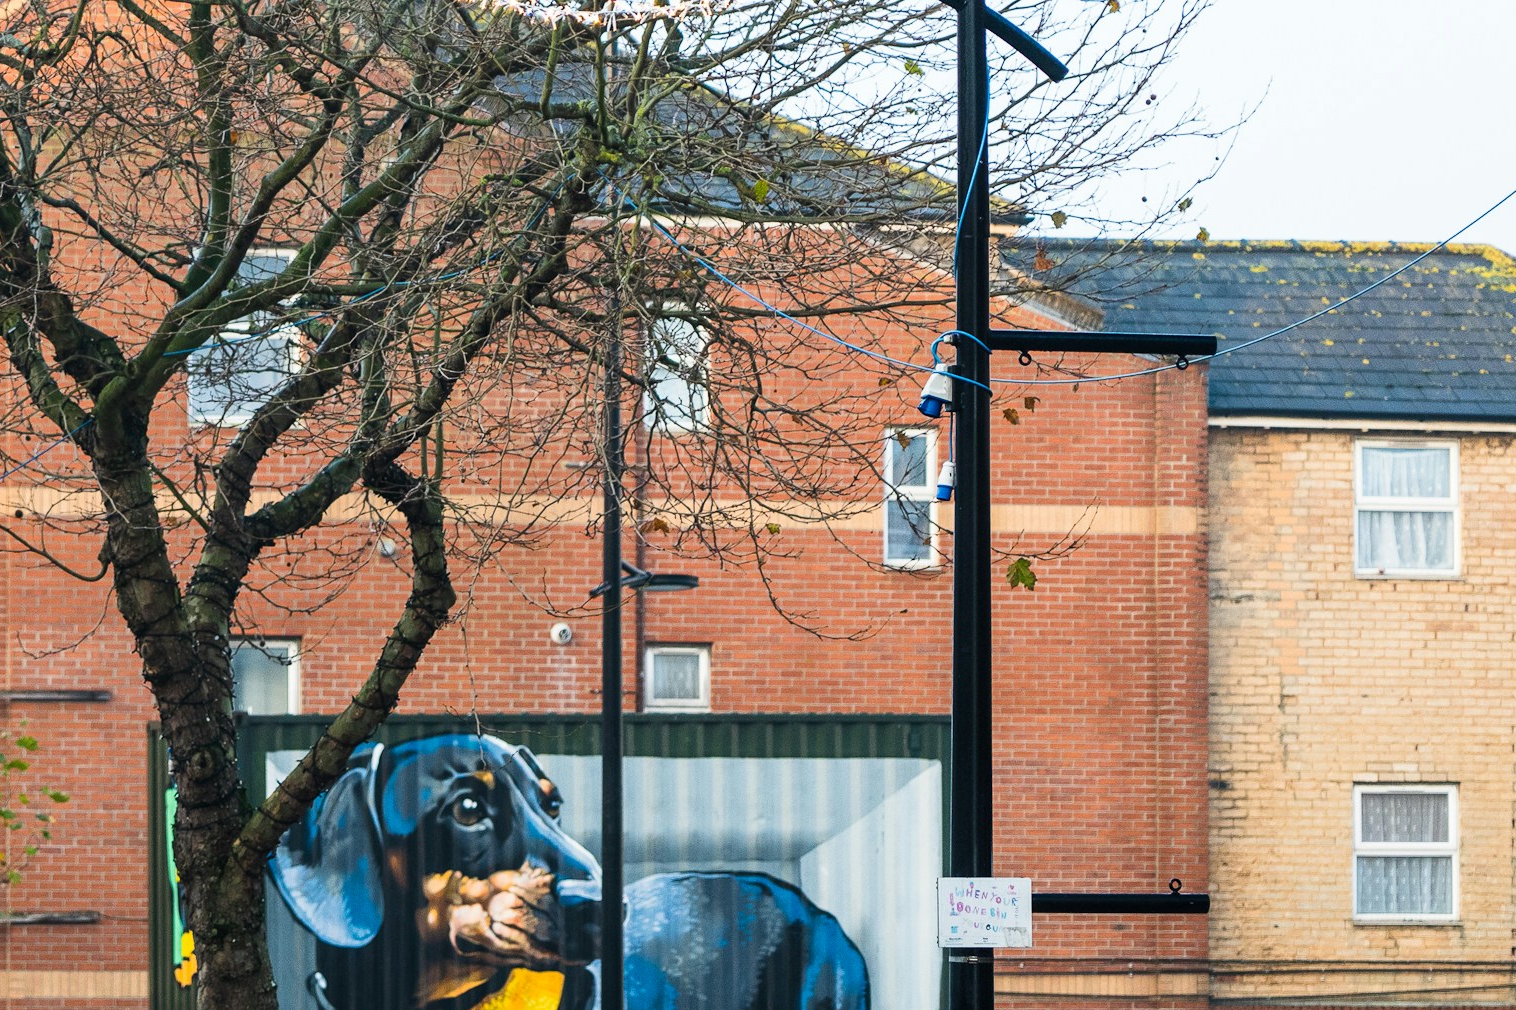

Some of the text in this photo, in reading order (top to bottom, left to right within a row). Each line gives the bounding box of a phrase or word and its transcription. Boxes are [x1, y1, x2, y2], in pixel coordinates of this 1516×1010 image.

[955, 886, 1019, 907] WHEN YOUR
[956, 901, 987, 916] DONE
